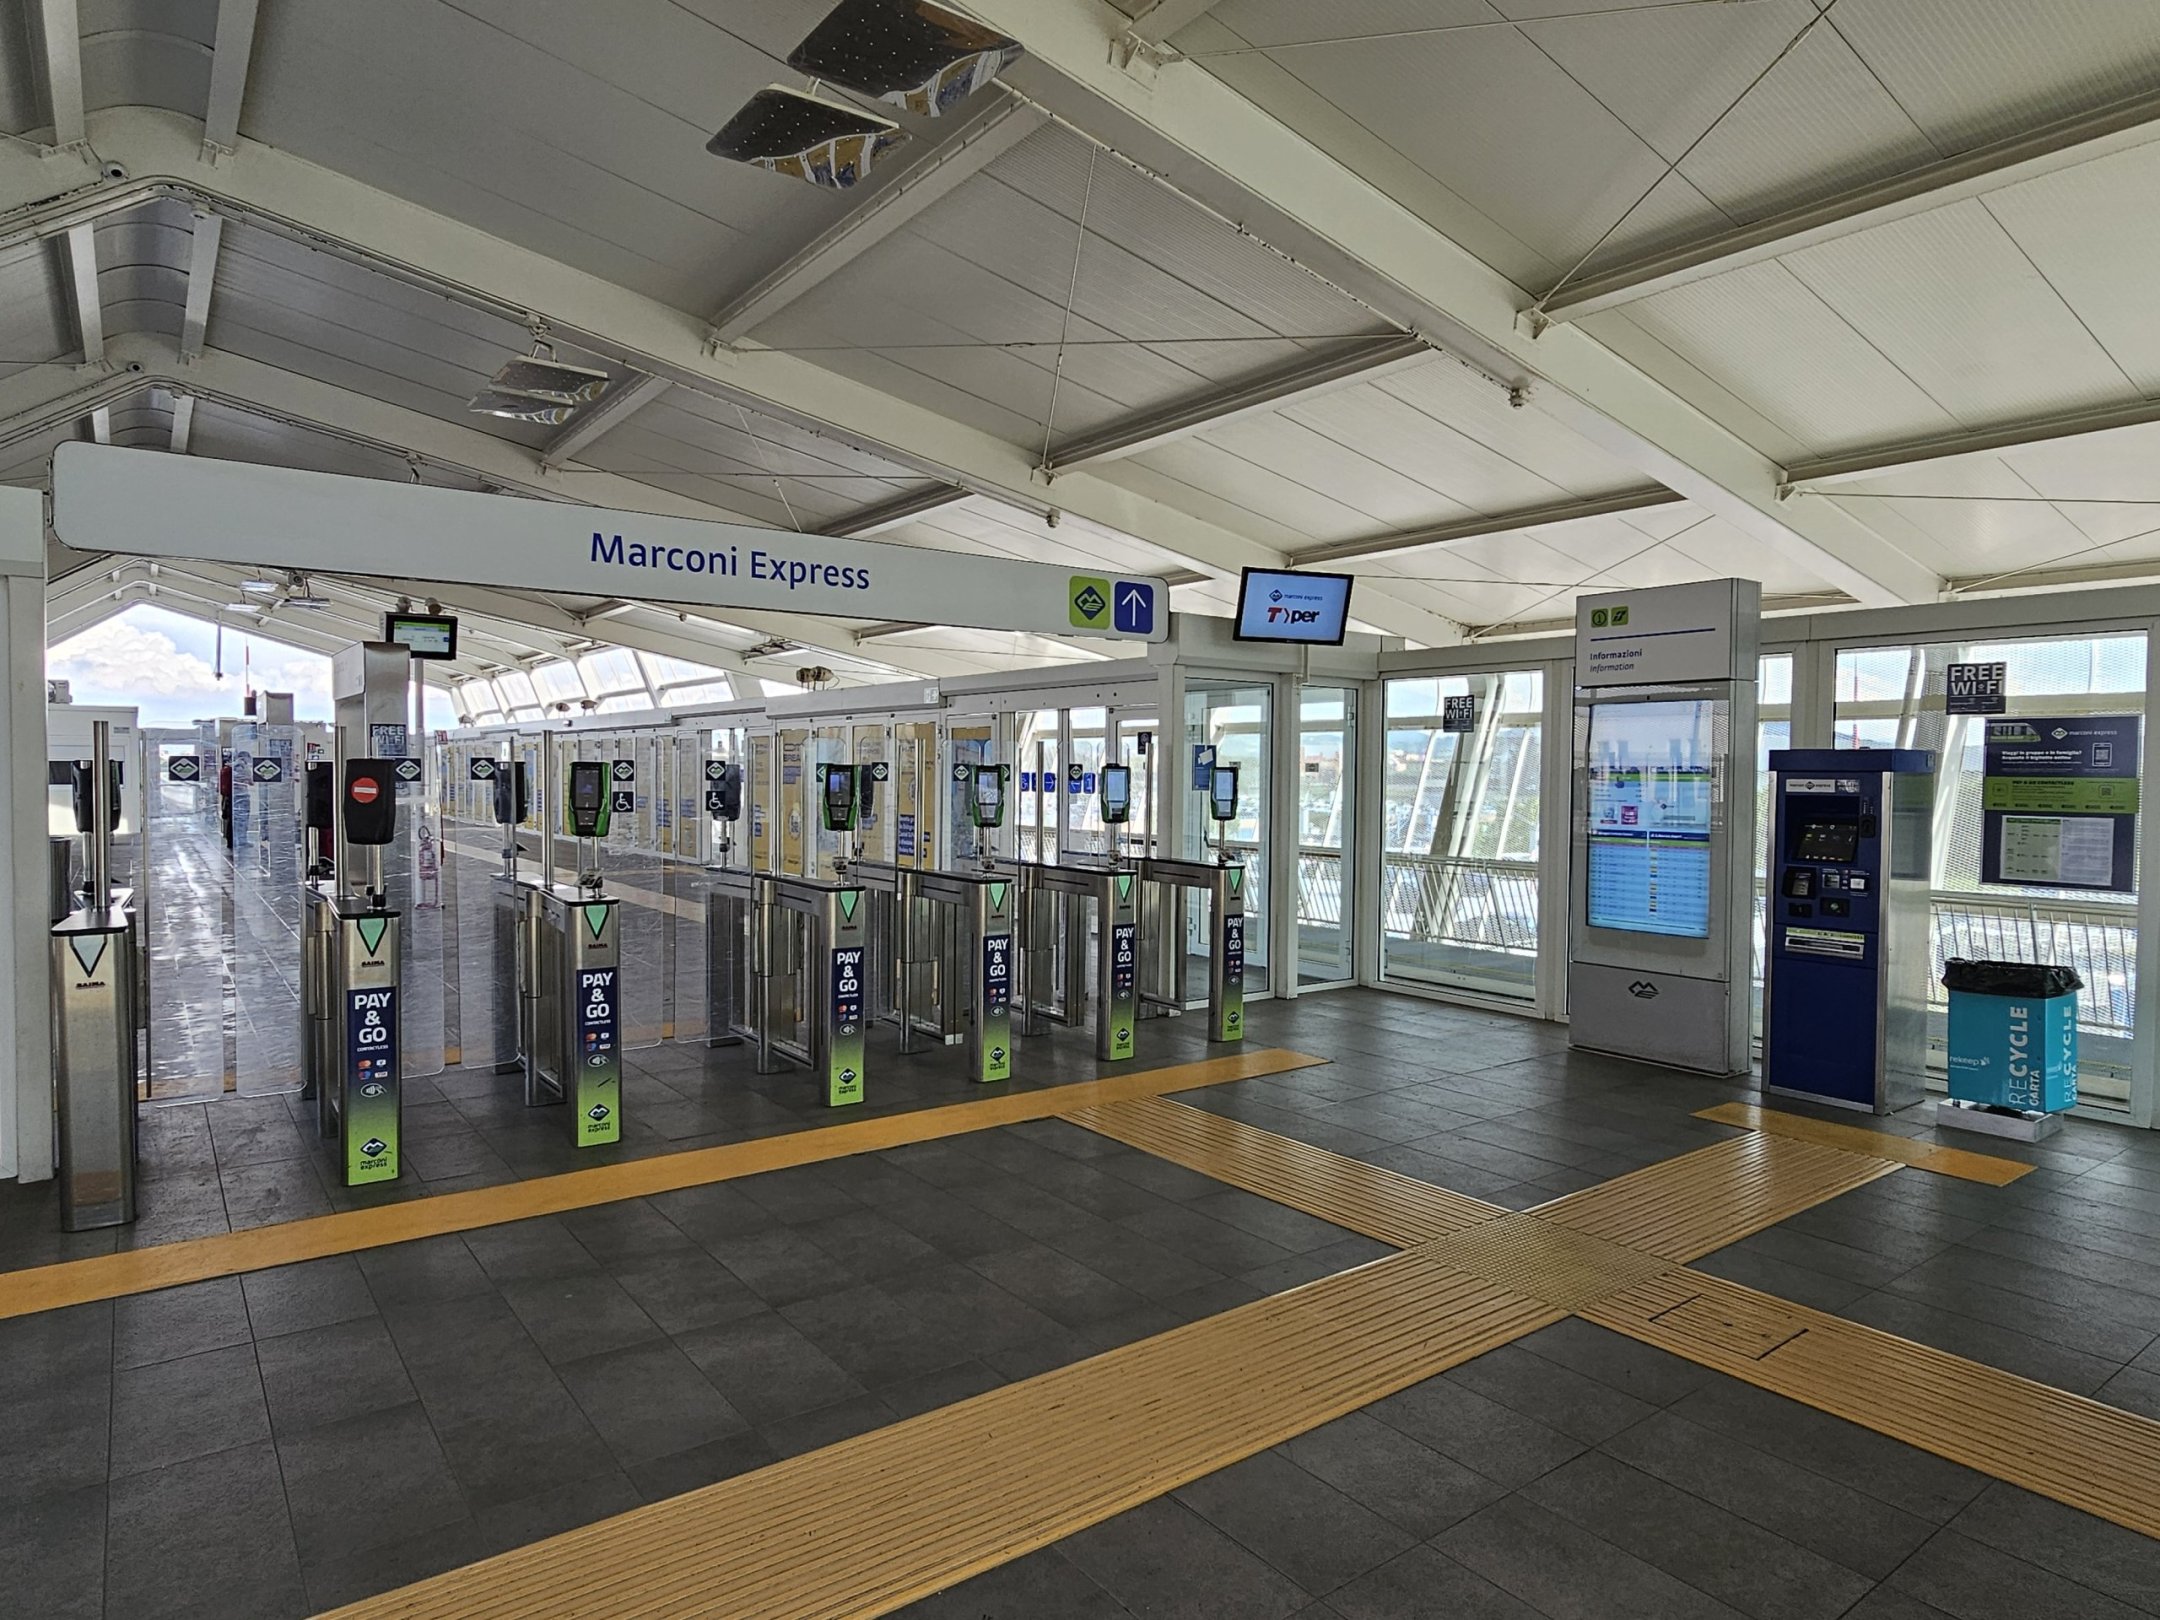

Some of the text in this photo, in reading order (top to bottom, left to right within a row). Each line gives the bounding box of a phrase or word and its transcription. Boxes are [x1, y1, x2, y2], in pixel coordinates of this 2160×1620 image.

[590, 533, 870, 590] Marconi Express
[1590, 648, 1643, 661] Informazioni
[1950, 664, 2003, 681] FREE
[1445, 697, 1473, 709] FREE
[372, 725, 405, 736] FREE
[1227, 917, 1243, 928] PAY
[1116, 928, 1134, 939] PAY
[1231, 928, 1238, 939] &
[987, 939, 1008, 951] PAY
[1121, 939, 1128, 950] &
[1229, 939, 1241, 950] GO
[837, 951, 861, 965] PAY
[993, 951, 1002, 963] &
[1117, 951, 1131, 962] GO
[843, 965, 854, 978] &
[989, 964, 1006, 976] GO
[582, 972, 613, 988] PAY
[839, 979, 858, 992] GO
[354, 993, 391, 1010] PAY
[591, 988, 605, 1002] &
[586, 1003, 610, 1018] GO
[365, 1010, 381, 1026] &
[358, 1027, 387, 1044] GO
[1949, 1056, 1980, 1066] rekeep
[2008, 1006, 2028, 1106] RECYCLE
[2063, 1006, 2072, 1103] RECYCLE
[2029, 1070, 2041, 1107] CARTA
